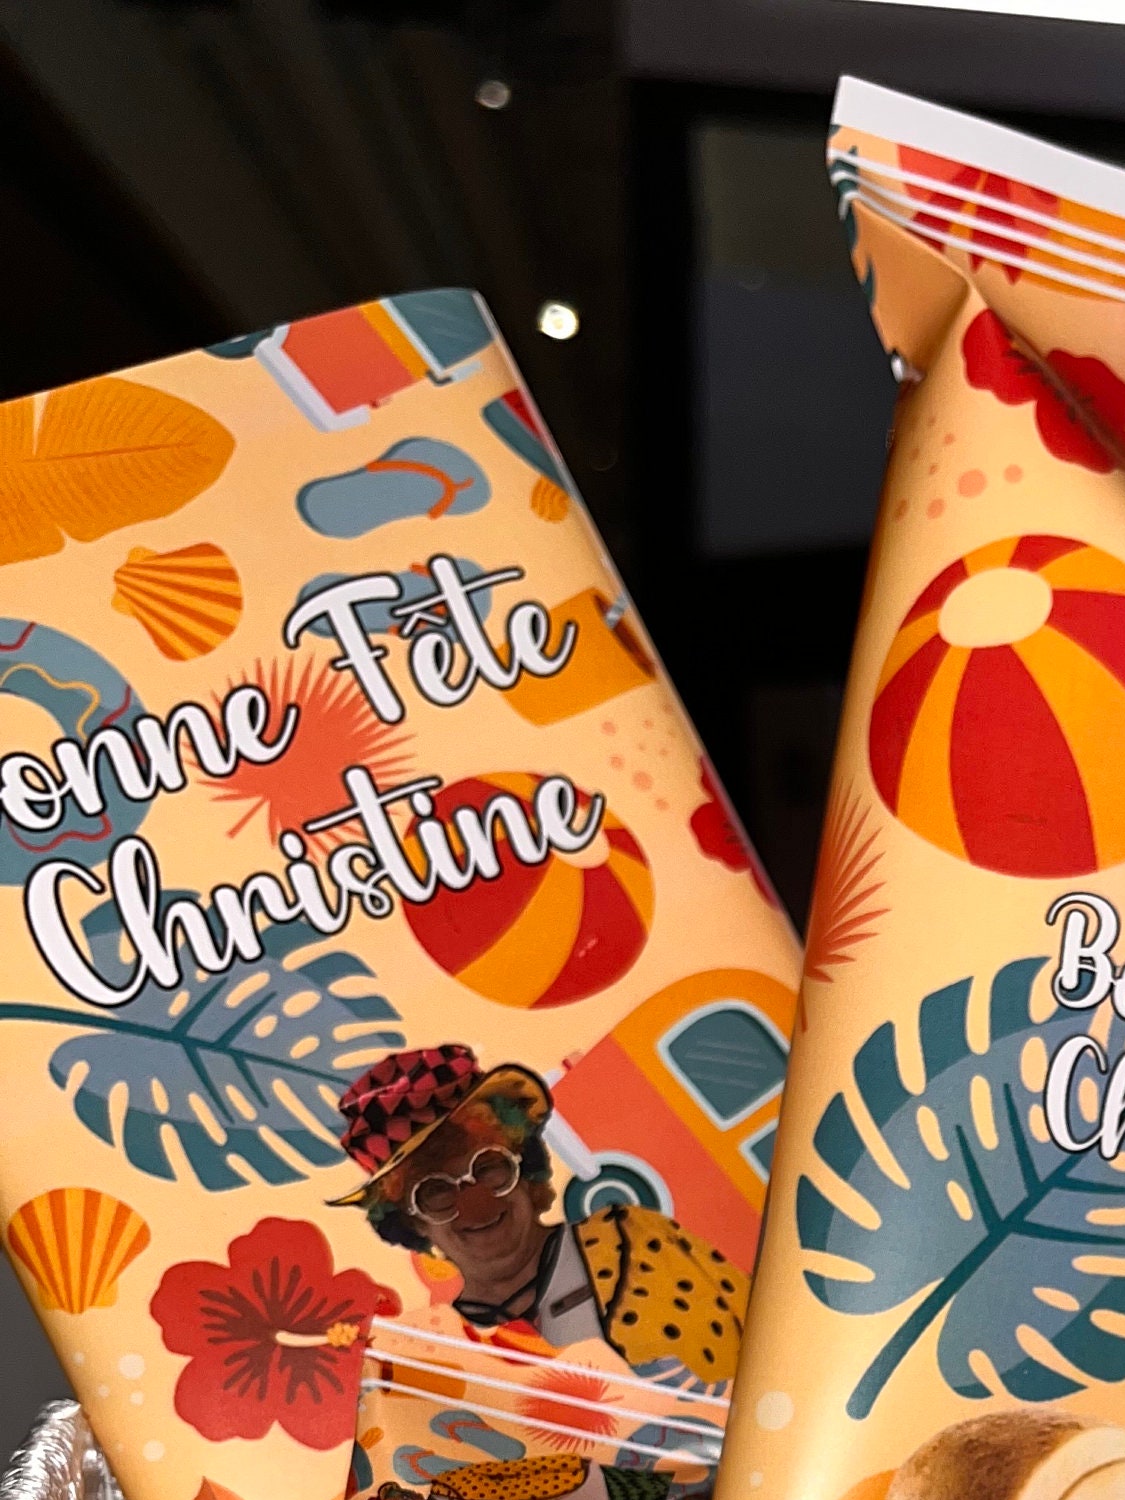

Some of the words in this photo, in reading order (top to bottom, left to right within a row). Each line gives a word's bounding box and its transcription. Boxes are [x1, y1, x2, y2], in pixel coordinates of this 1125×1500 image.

[0, 685, 298, 832] onne
[284, 554, 578, 724] Fête
[23, 765, 606, 1010] Christine
